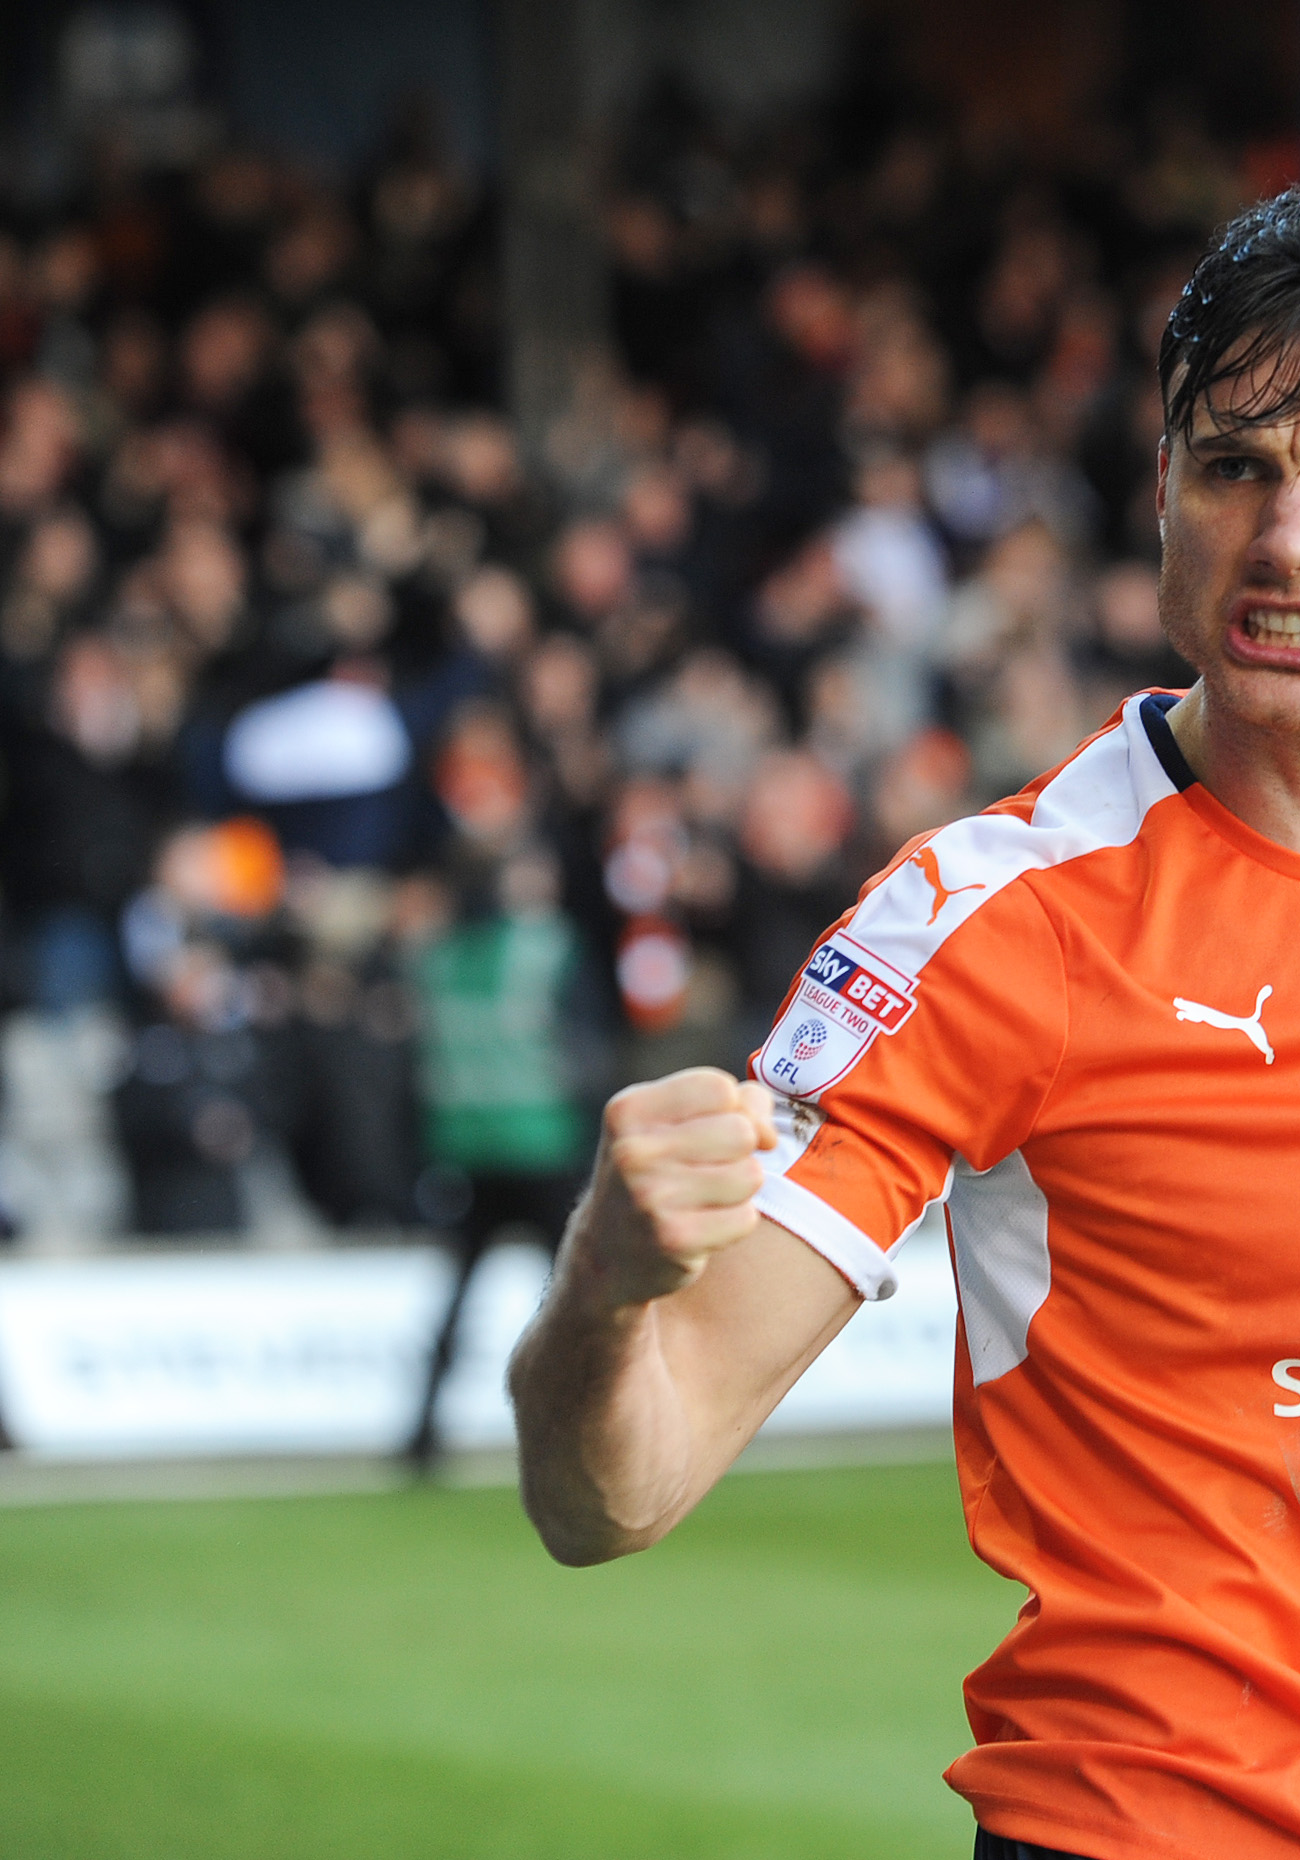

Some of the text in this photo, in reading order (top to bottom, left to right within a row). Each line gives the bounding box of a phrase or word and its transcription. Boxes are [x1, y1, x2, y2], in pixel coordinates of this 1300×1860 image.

[804, 984, 869, 1034] LEAGUE TWO
[847, 973, 904, 1019] BET
[773, 1057, 799, 1085] EFL
